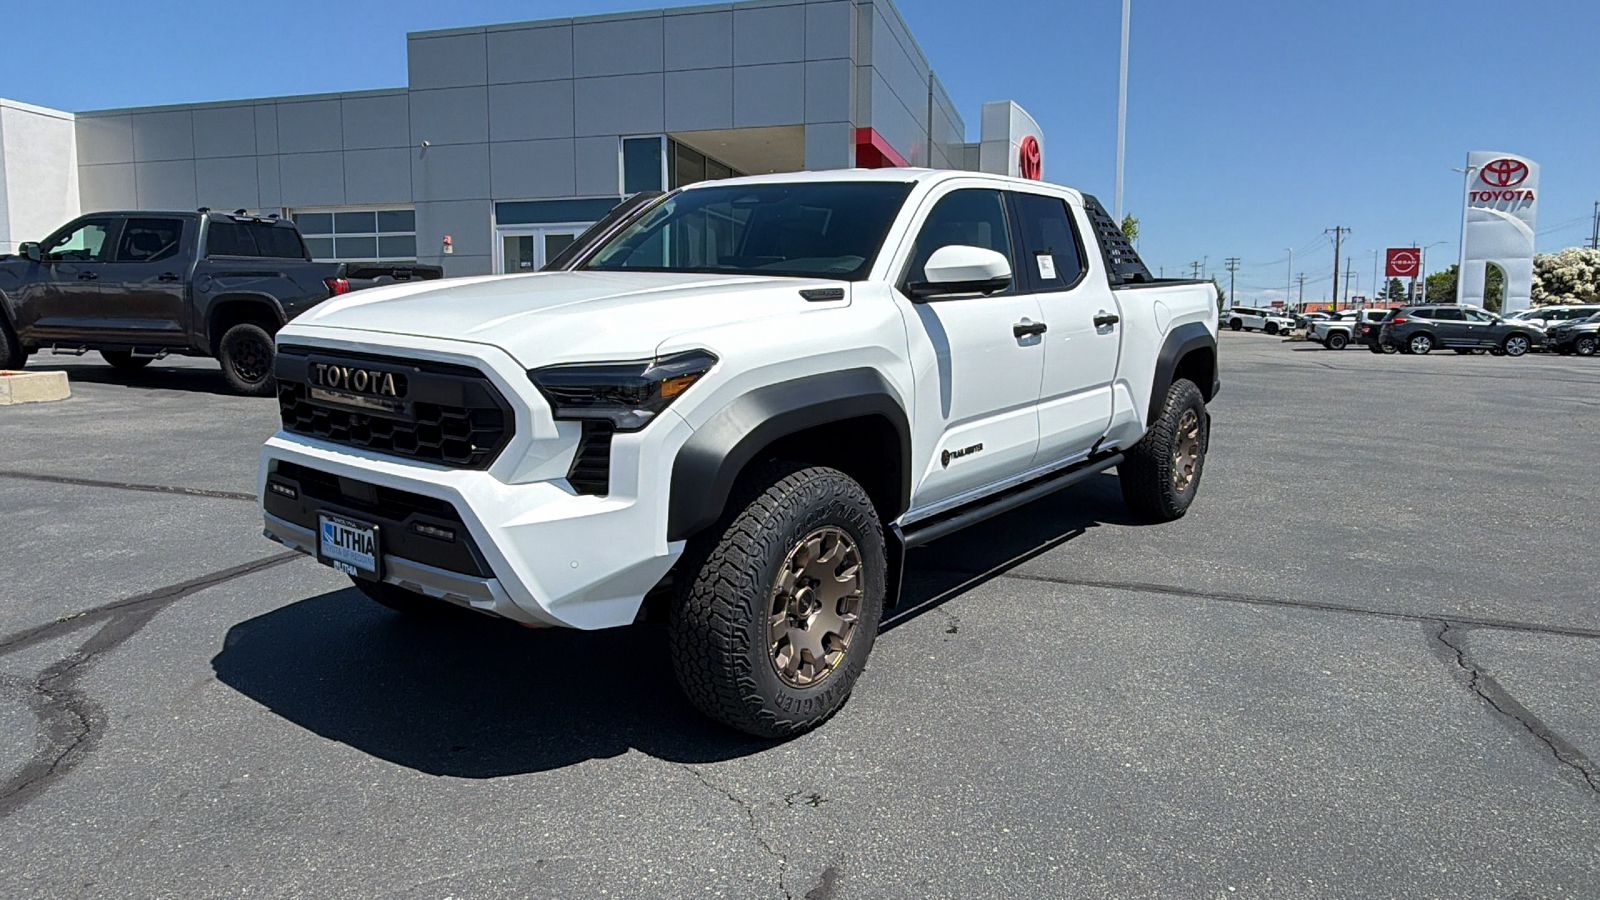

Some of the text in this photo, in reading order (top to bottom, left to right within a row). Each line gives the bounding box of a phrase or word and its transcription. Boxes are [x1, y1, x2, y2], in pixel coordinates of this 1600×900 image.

[1469, 190, 1535, 202] TOYOTA
[316, 363, 396, 396] TOYOTA
[333, 525, 375, 555] LITHIA
[774, 661, 858, 715] WRANGLER
